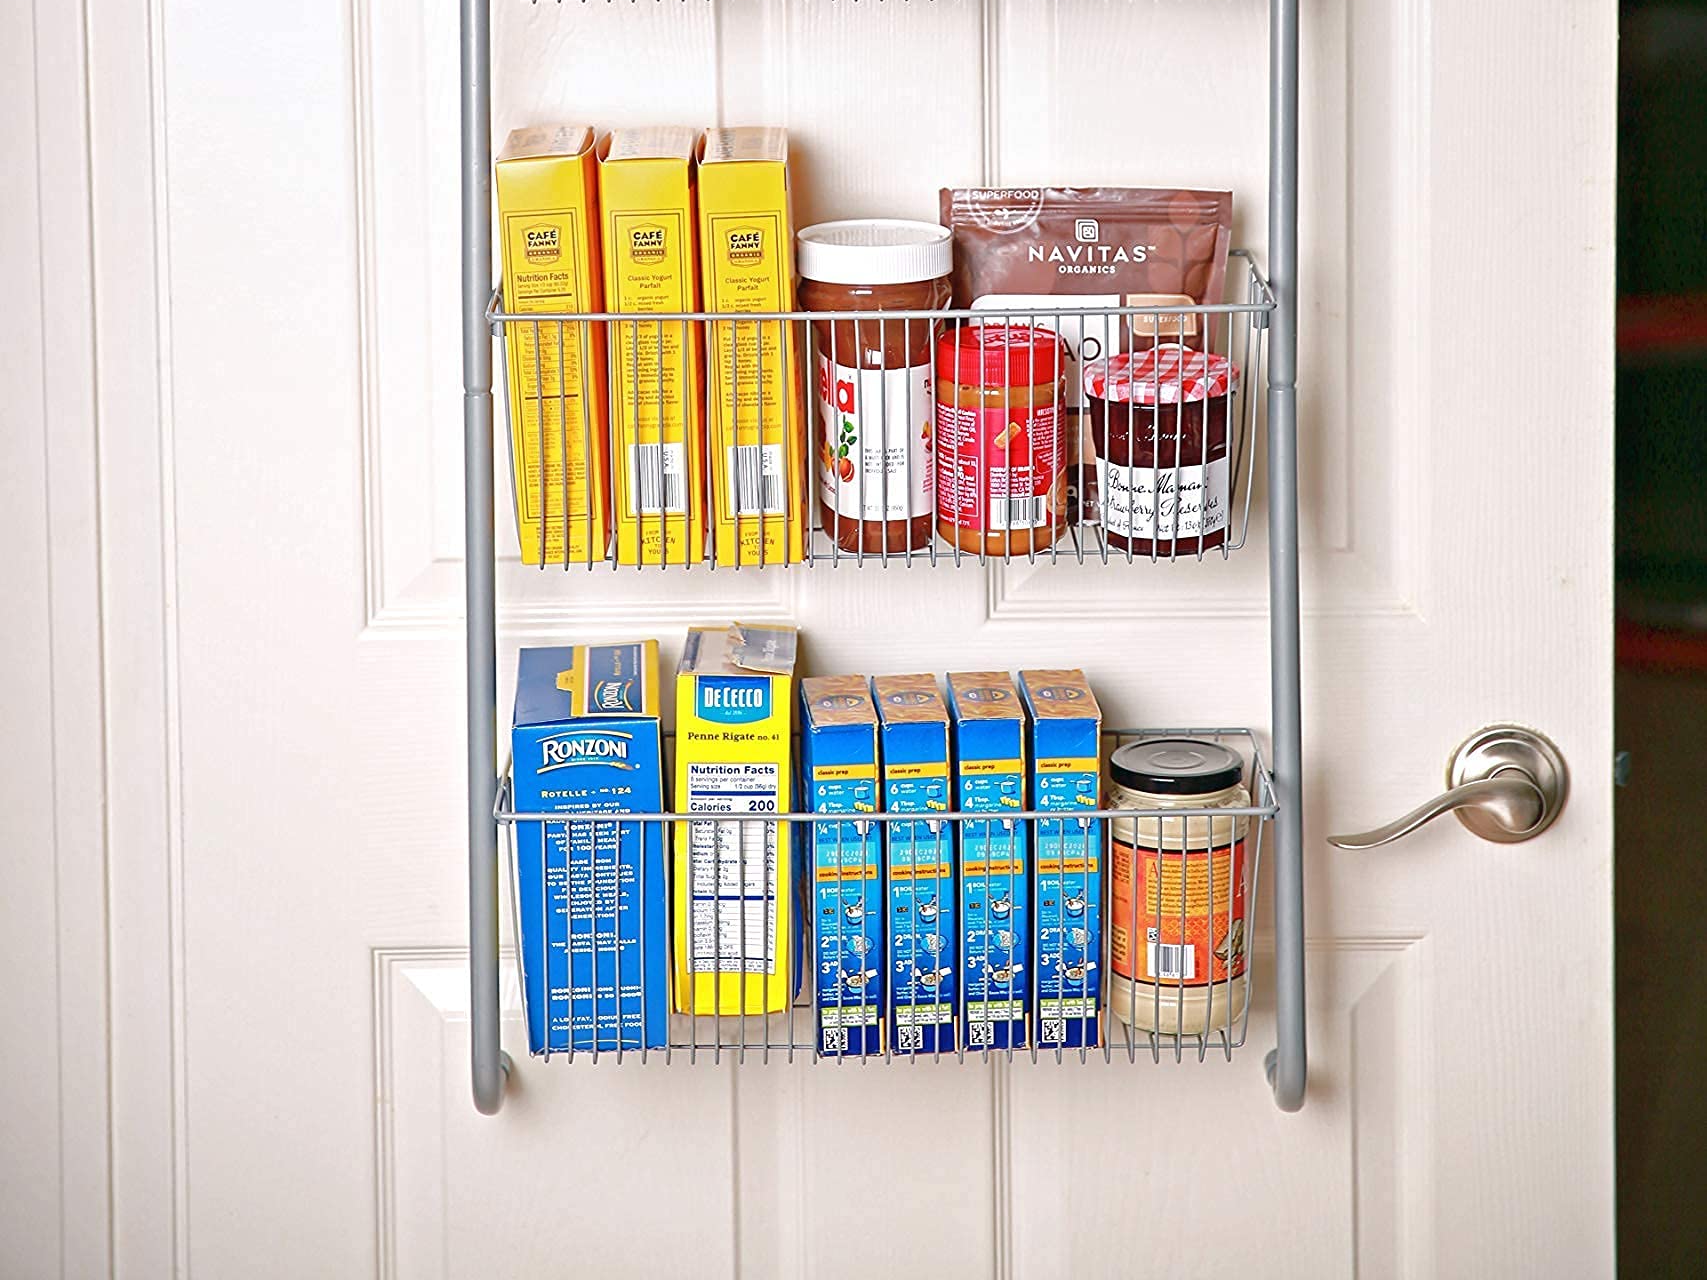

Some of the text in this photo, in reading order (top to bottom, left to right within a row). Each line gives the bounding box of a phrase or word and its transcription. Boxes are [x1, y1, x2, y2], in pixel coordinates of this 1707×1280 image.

[971, 189, 1039, 201] SUPERFOOD
[527, 229, 557, 241] CAFÉ
[633, 230, 663, 240] CAFÉ
[730, 232, 760, 243] CAFÉ
[528, 239, 557, 248] FANNY
[633, 239, 663, 248] FANNY
[731, 241, 760, 250] FANNY
[1028, 245, 1148, 263] NAVITAS
[1058, 264, 1116, 275] ORGANICS
[516, 273, 569, 283] Nutrition Facts
[627, 274, 673, 283] Classic Yogurt
[725, 276, 770, 285] Classic Yogurt
[639, 282, 662, 290] Parfait
[737, 284, 759, 292] Parfait
[640, 537, 676, 546] KITCEN
[740, 538, 775, 547] KITCEN
[704, 686, 763, 708] DE CECCO
[687, 732, 720, 741] Penne
[722, 732, 755, 743] Rigate
[543, 739, 627, 766] RONZONI
[691, 765, 775, 775] Nutrition Facts
[964, 780, 973, 791] 6
[1040, 778, 1049, 789] 6
[541, 789, 588, 799] ROTELLE
[611, 786, 632, 795] 124
[817, 785, 827, 796] 6
[889, 784, 899, 795] 6
[748, 800, 775, 811] 200
[964, 796, 974, 809] 4
[1040, 794, 1050, 807] 4
[690, 802, 732, 811] Calories
[817, 802, 828, 814] 4
[889, 800, 900, 813] 4
[967, 930, 976, 943] 2
[1040, 928, 1050, 940] 2
[821, 935, 830, 948] 2
[894, 934, 903, 947] 2
[967, 956, 977, 969] 3
[1041, 953, 1050, 966] 3
[821, 962, 831, 974] 3
[895, 960, 904, 973] 3
